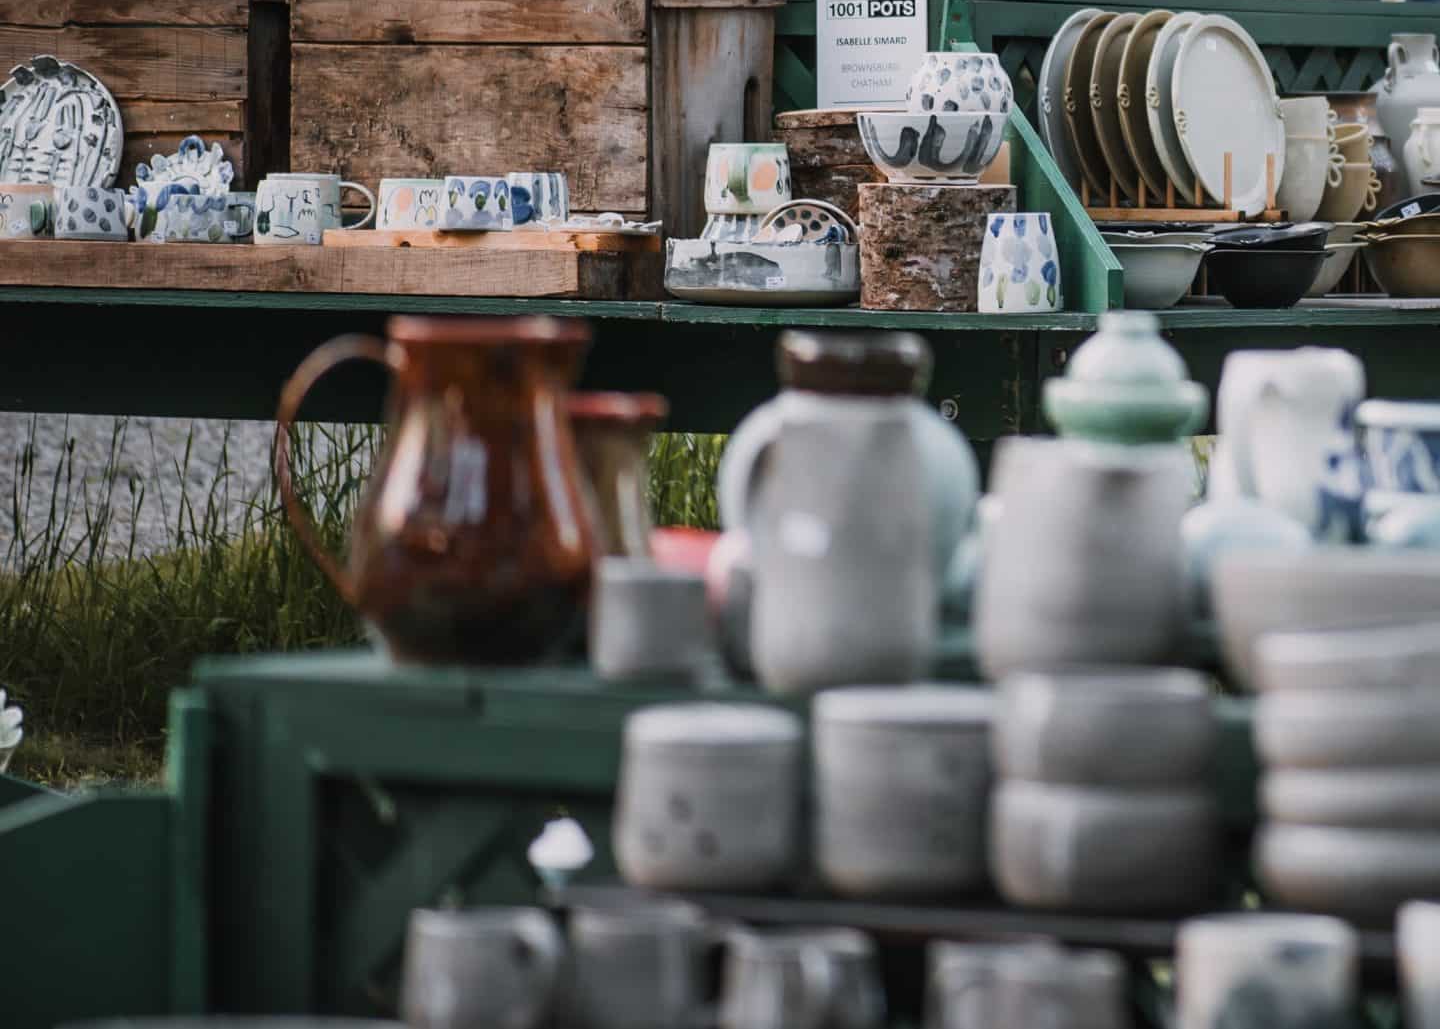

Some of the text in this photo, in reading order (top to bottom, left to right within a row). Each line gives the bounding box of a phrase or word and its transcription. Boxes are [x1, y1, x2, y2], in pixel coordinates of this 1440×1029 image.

[828, 0, 914, 17] 1001 POTS
[836, 36, 908, 46] ISABELLE SIMARD
